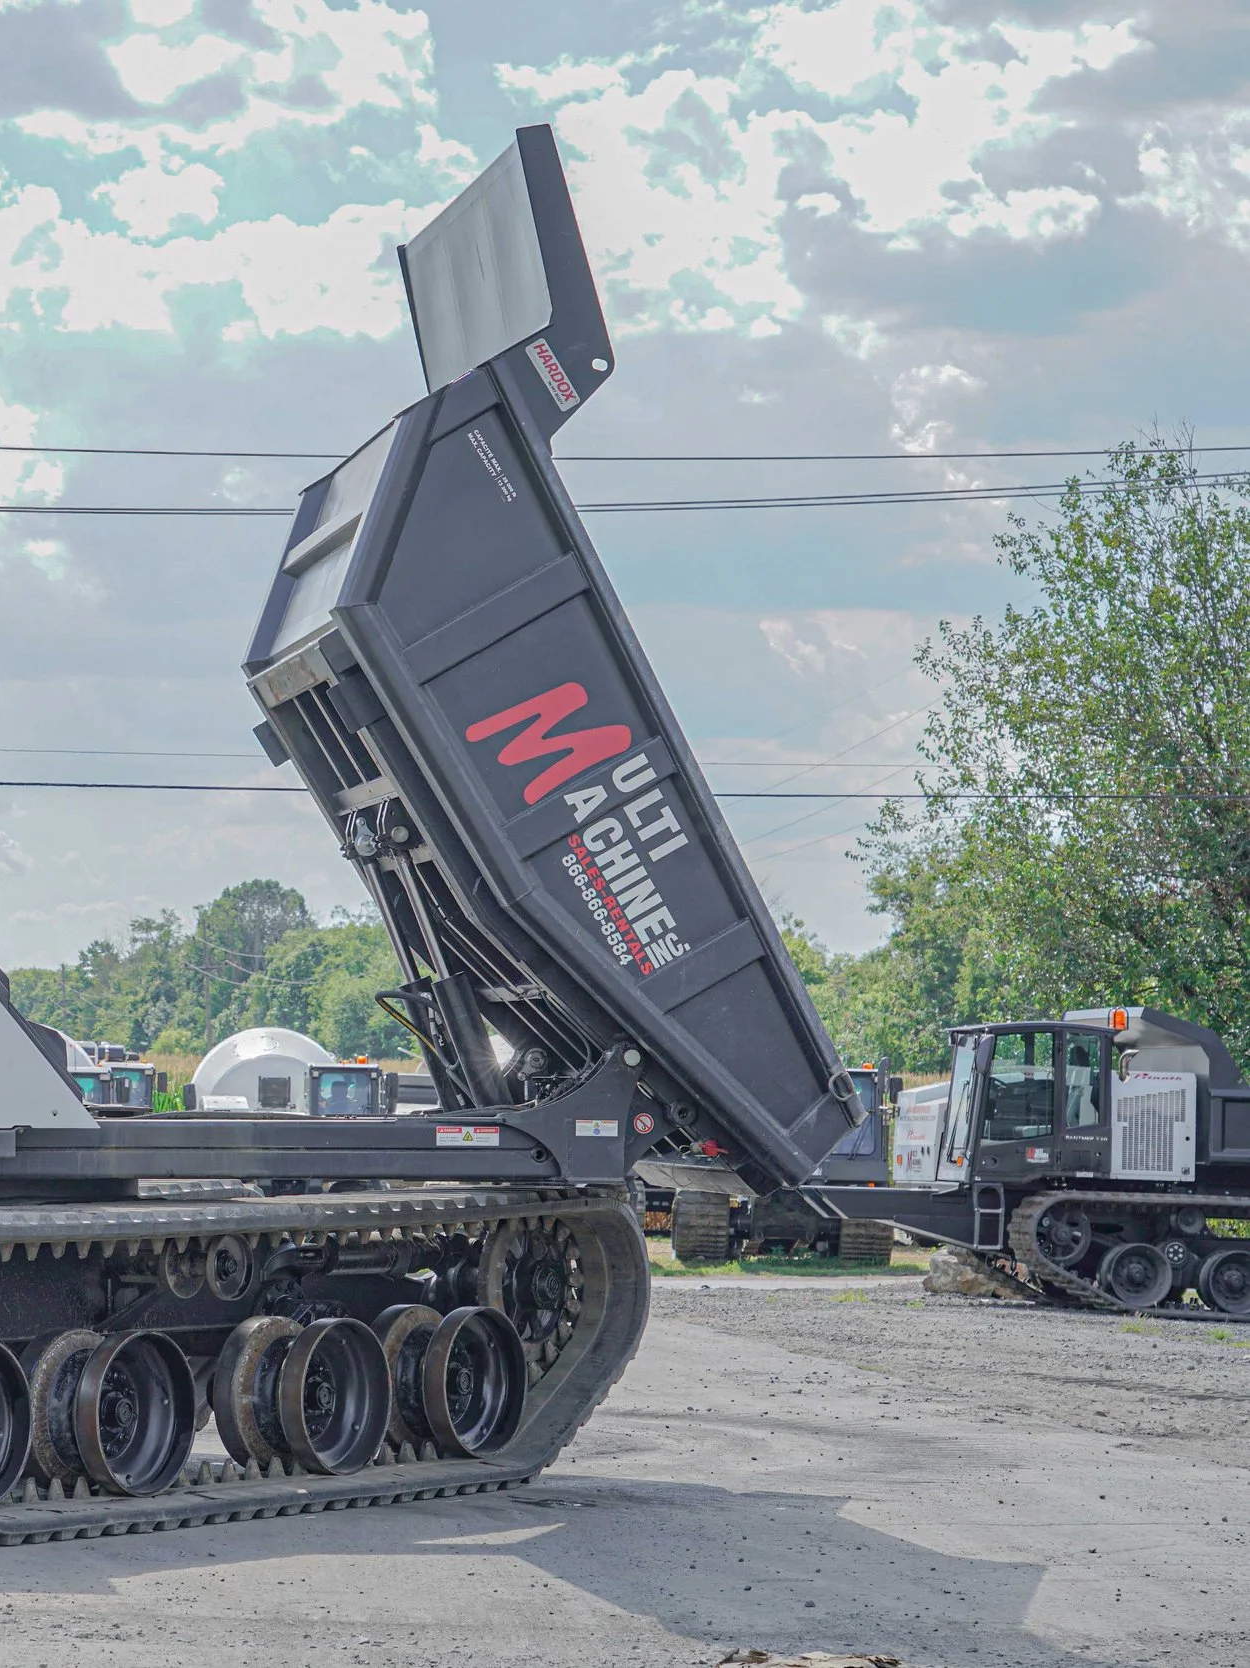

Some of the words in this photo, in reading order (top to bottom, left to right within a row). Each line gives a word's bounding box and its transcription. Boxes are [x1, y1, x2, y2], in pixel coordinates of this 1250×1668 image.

[533, 343, 576, 402] HARDOX
[467, 432, 478, 448] MAX.
[477, 448, 497, 476] CAPACITY
[491, 458, 502, 474] MAX.
[562, 853, 634, 966] 866-866-8584
[568, 834, 654, 975] SALES-RENTALS
[644, 932, 691, 969] INC.
